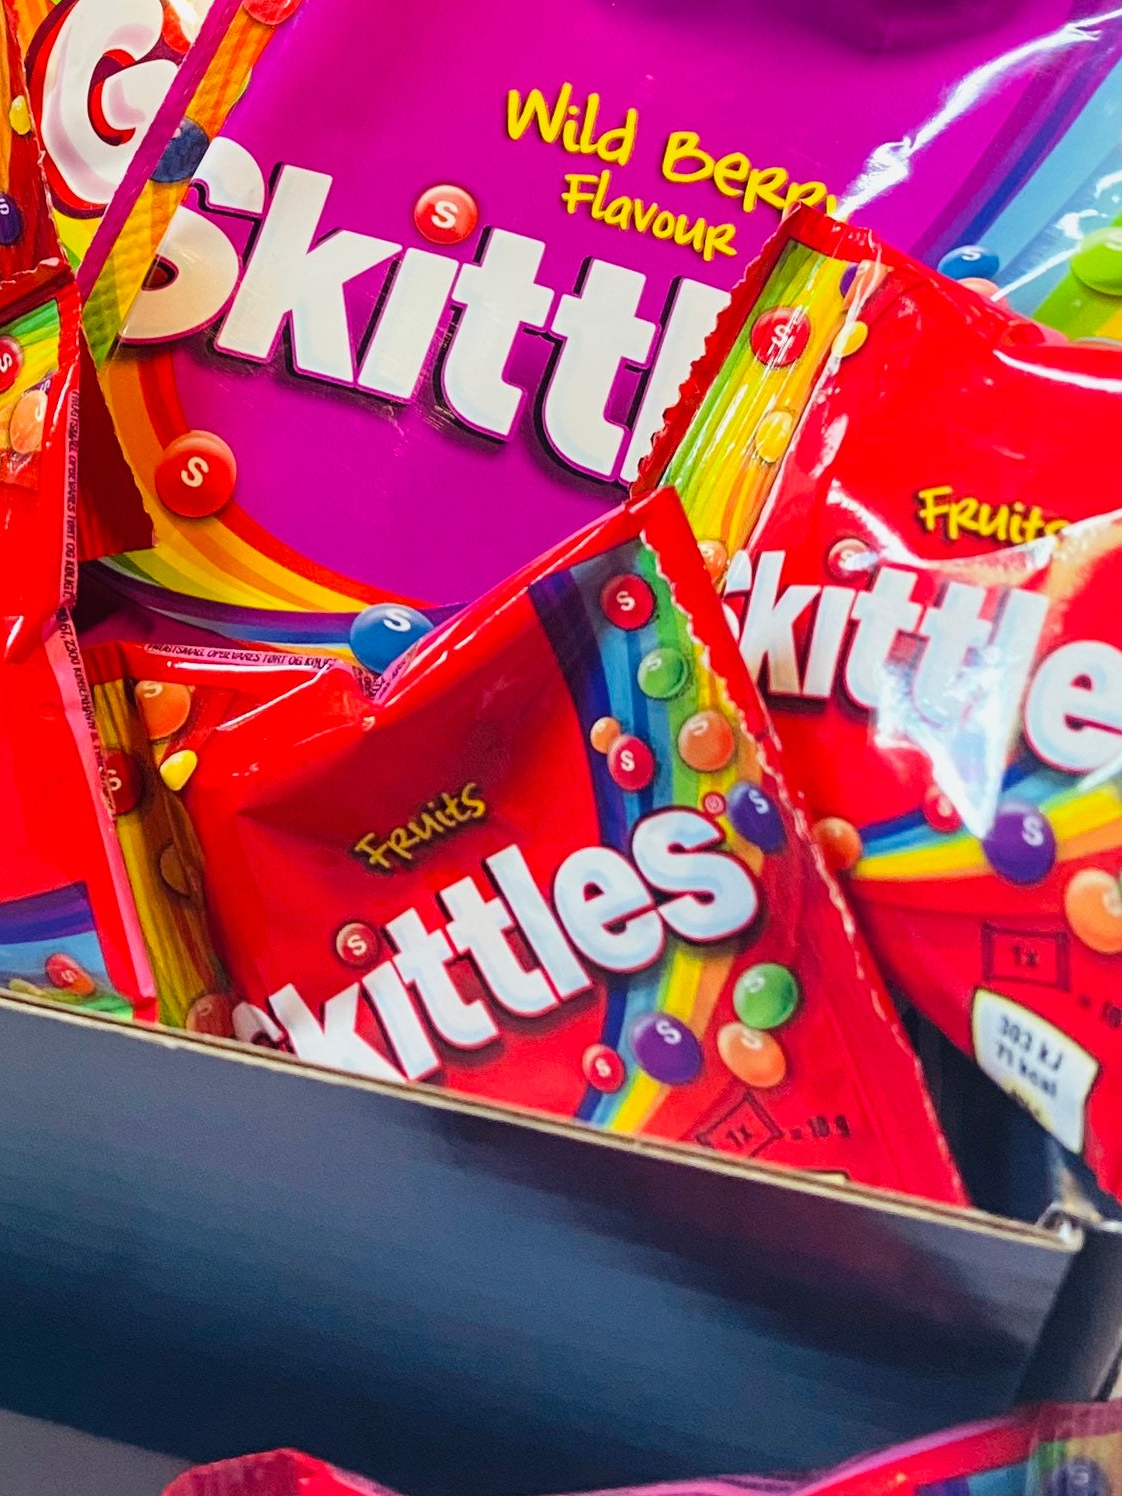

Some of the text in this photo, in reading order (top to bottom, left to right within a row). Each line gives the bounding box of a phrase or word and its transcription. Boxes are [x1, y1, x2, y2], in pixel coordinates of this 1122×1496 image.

[506, 81, 639, 167] Wild
[561, 169, 738, 263] Flavour
[116, 135, 731, 484] Skittl
[722, 548, 1122, 774] kittle
[352, 779, 487, 872] Fruits
